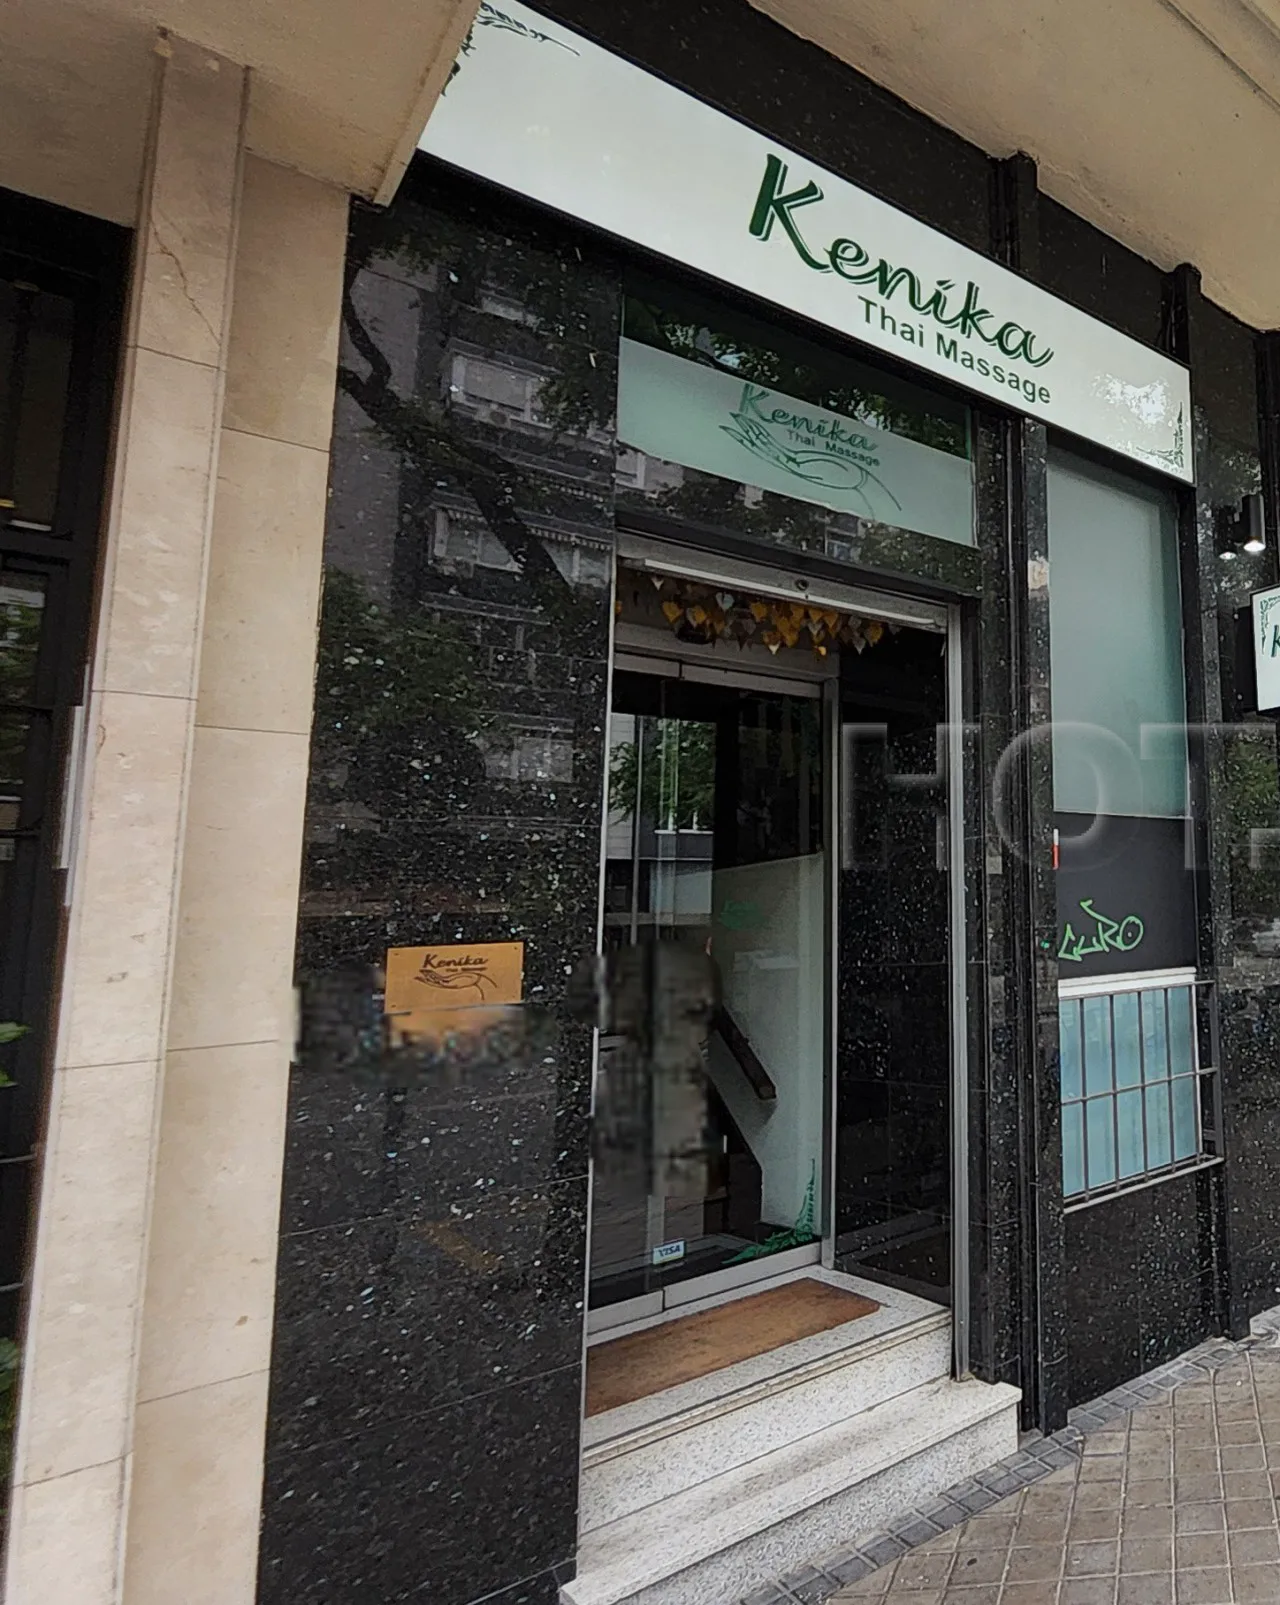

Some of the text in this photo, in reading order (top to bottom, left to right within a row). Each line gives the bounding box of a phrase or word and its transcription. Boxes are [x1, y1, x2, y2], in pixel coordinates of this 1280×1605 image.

[749, 153, 1054, 367] Kenika
[858, 295, 1051, 404] Thai Massage
[739, 383, 879, 450] Kenika
[787, 429, 881, 466] Thai Massage
[422, 953, 489, 969] Kenika
